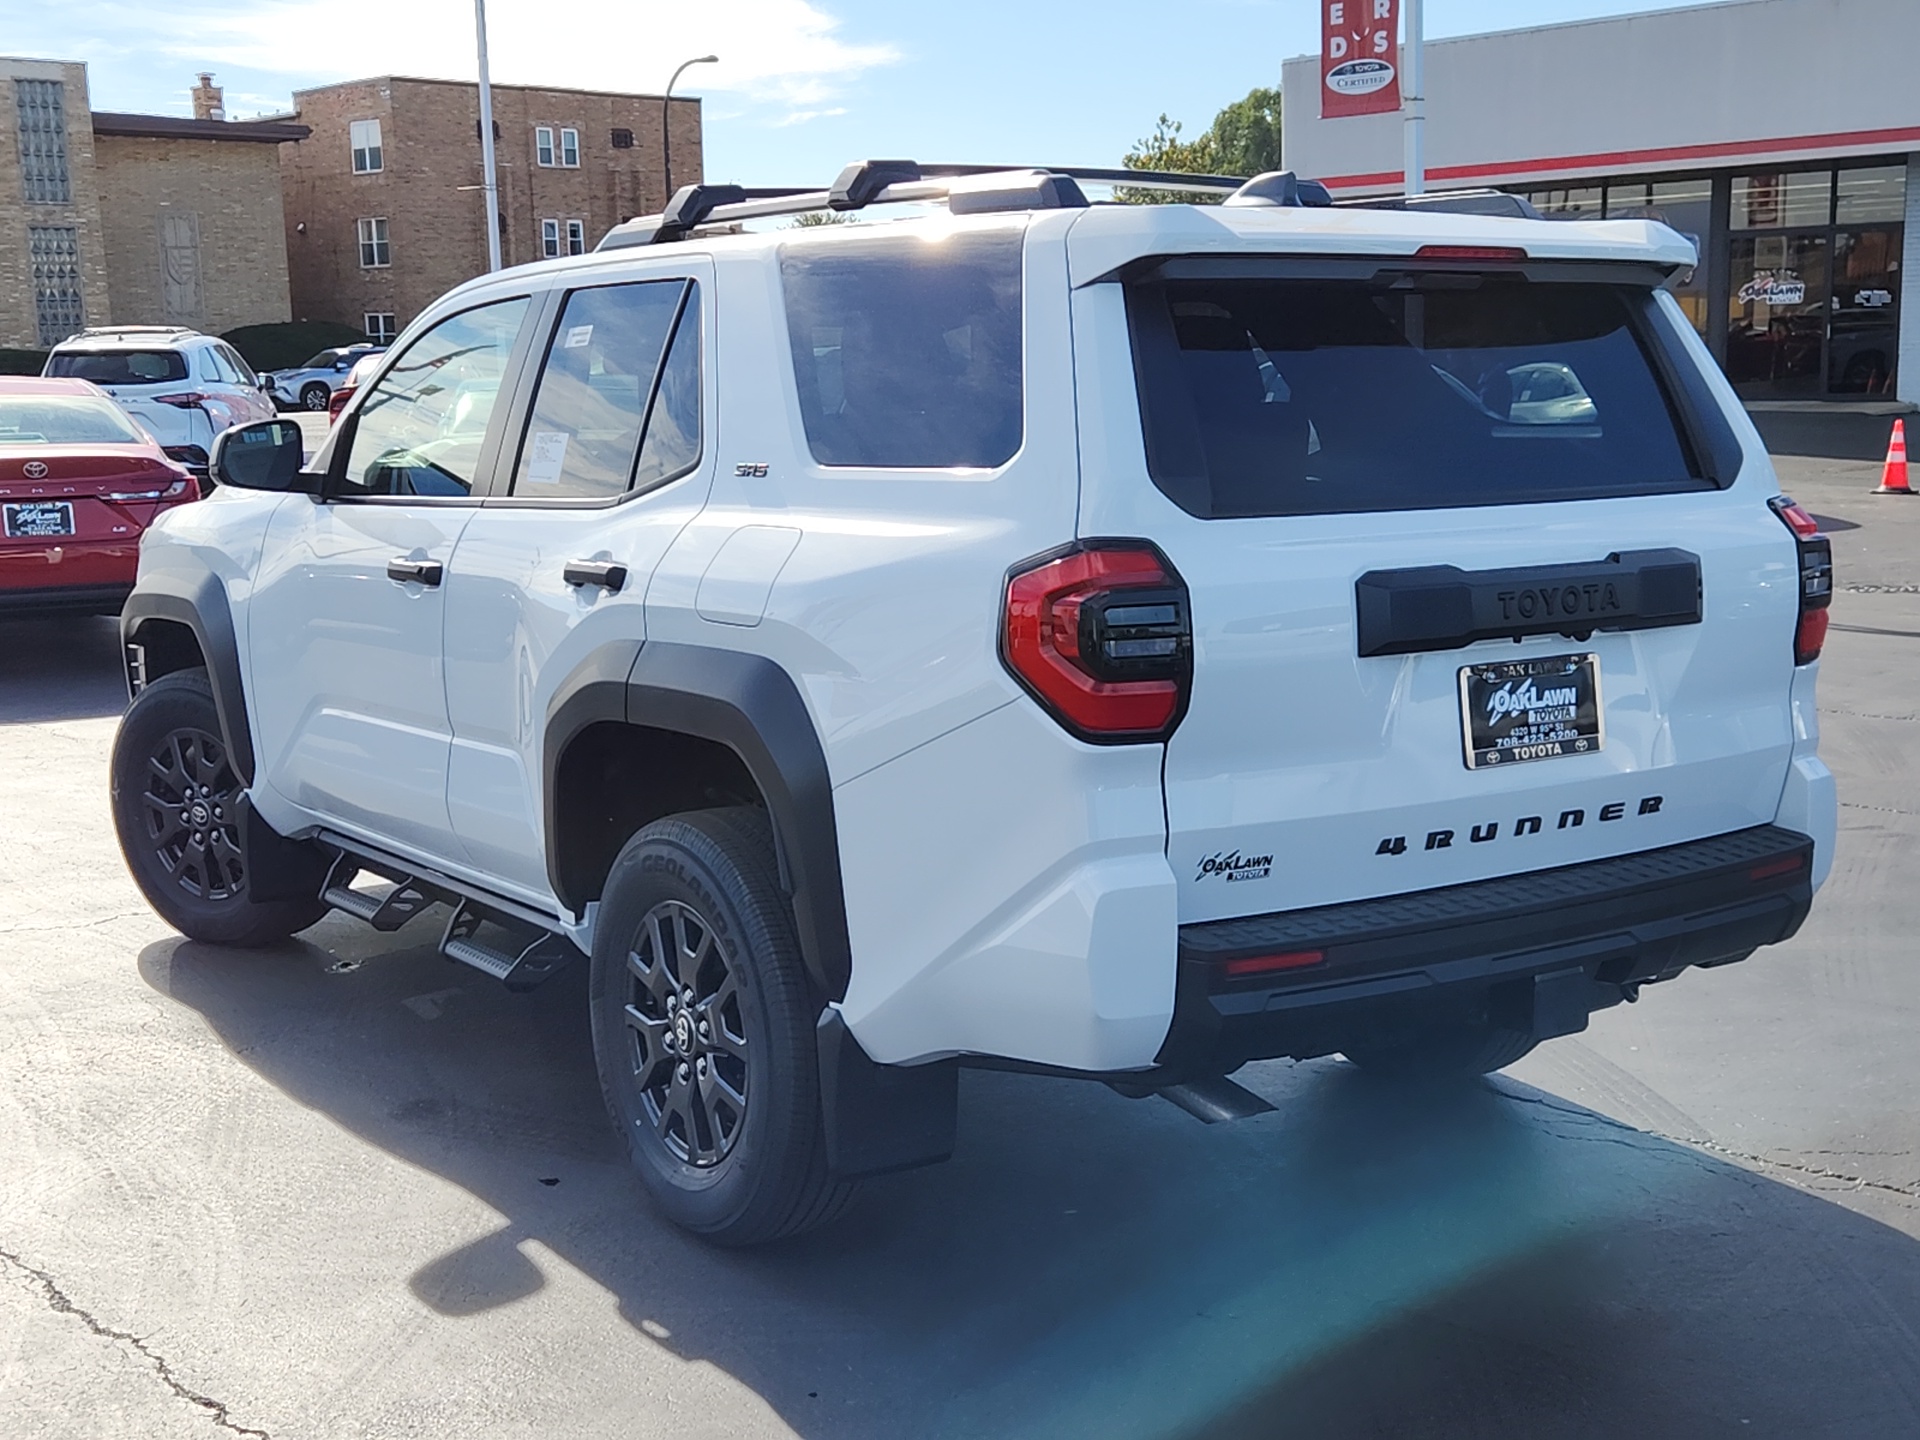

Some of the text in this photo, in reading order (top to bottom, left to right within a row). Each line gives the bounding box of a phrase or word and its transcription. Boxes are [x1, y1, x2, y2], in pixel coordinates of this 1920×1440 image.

[734, 462, 770, 479] SR5
[1497, 582, 1621, 620] TOYOTA
[1533, 707, 1572, 722] TOYOTA
[1529, 725, 1538, 735] W
[1555, 722, 1565, 732] St
[1512, 742, 1563, 760] TOYOTA
[1375, 796, 1664, 856] 4RUNNER
[1231, 869, 1265, 881] TOYOTA
